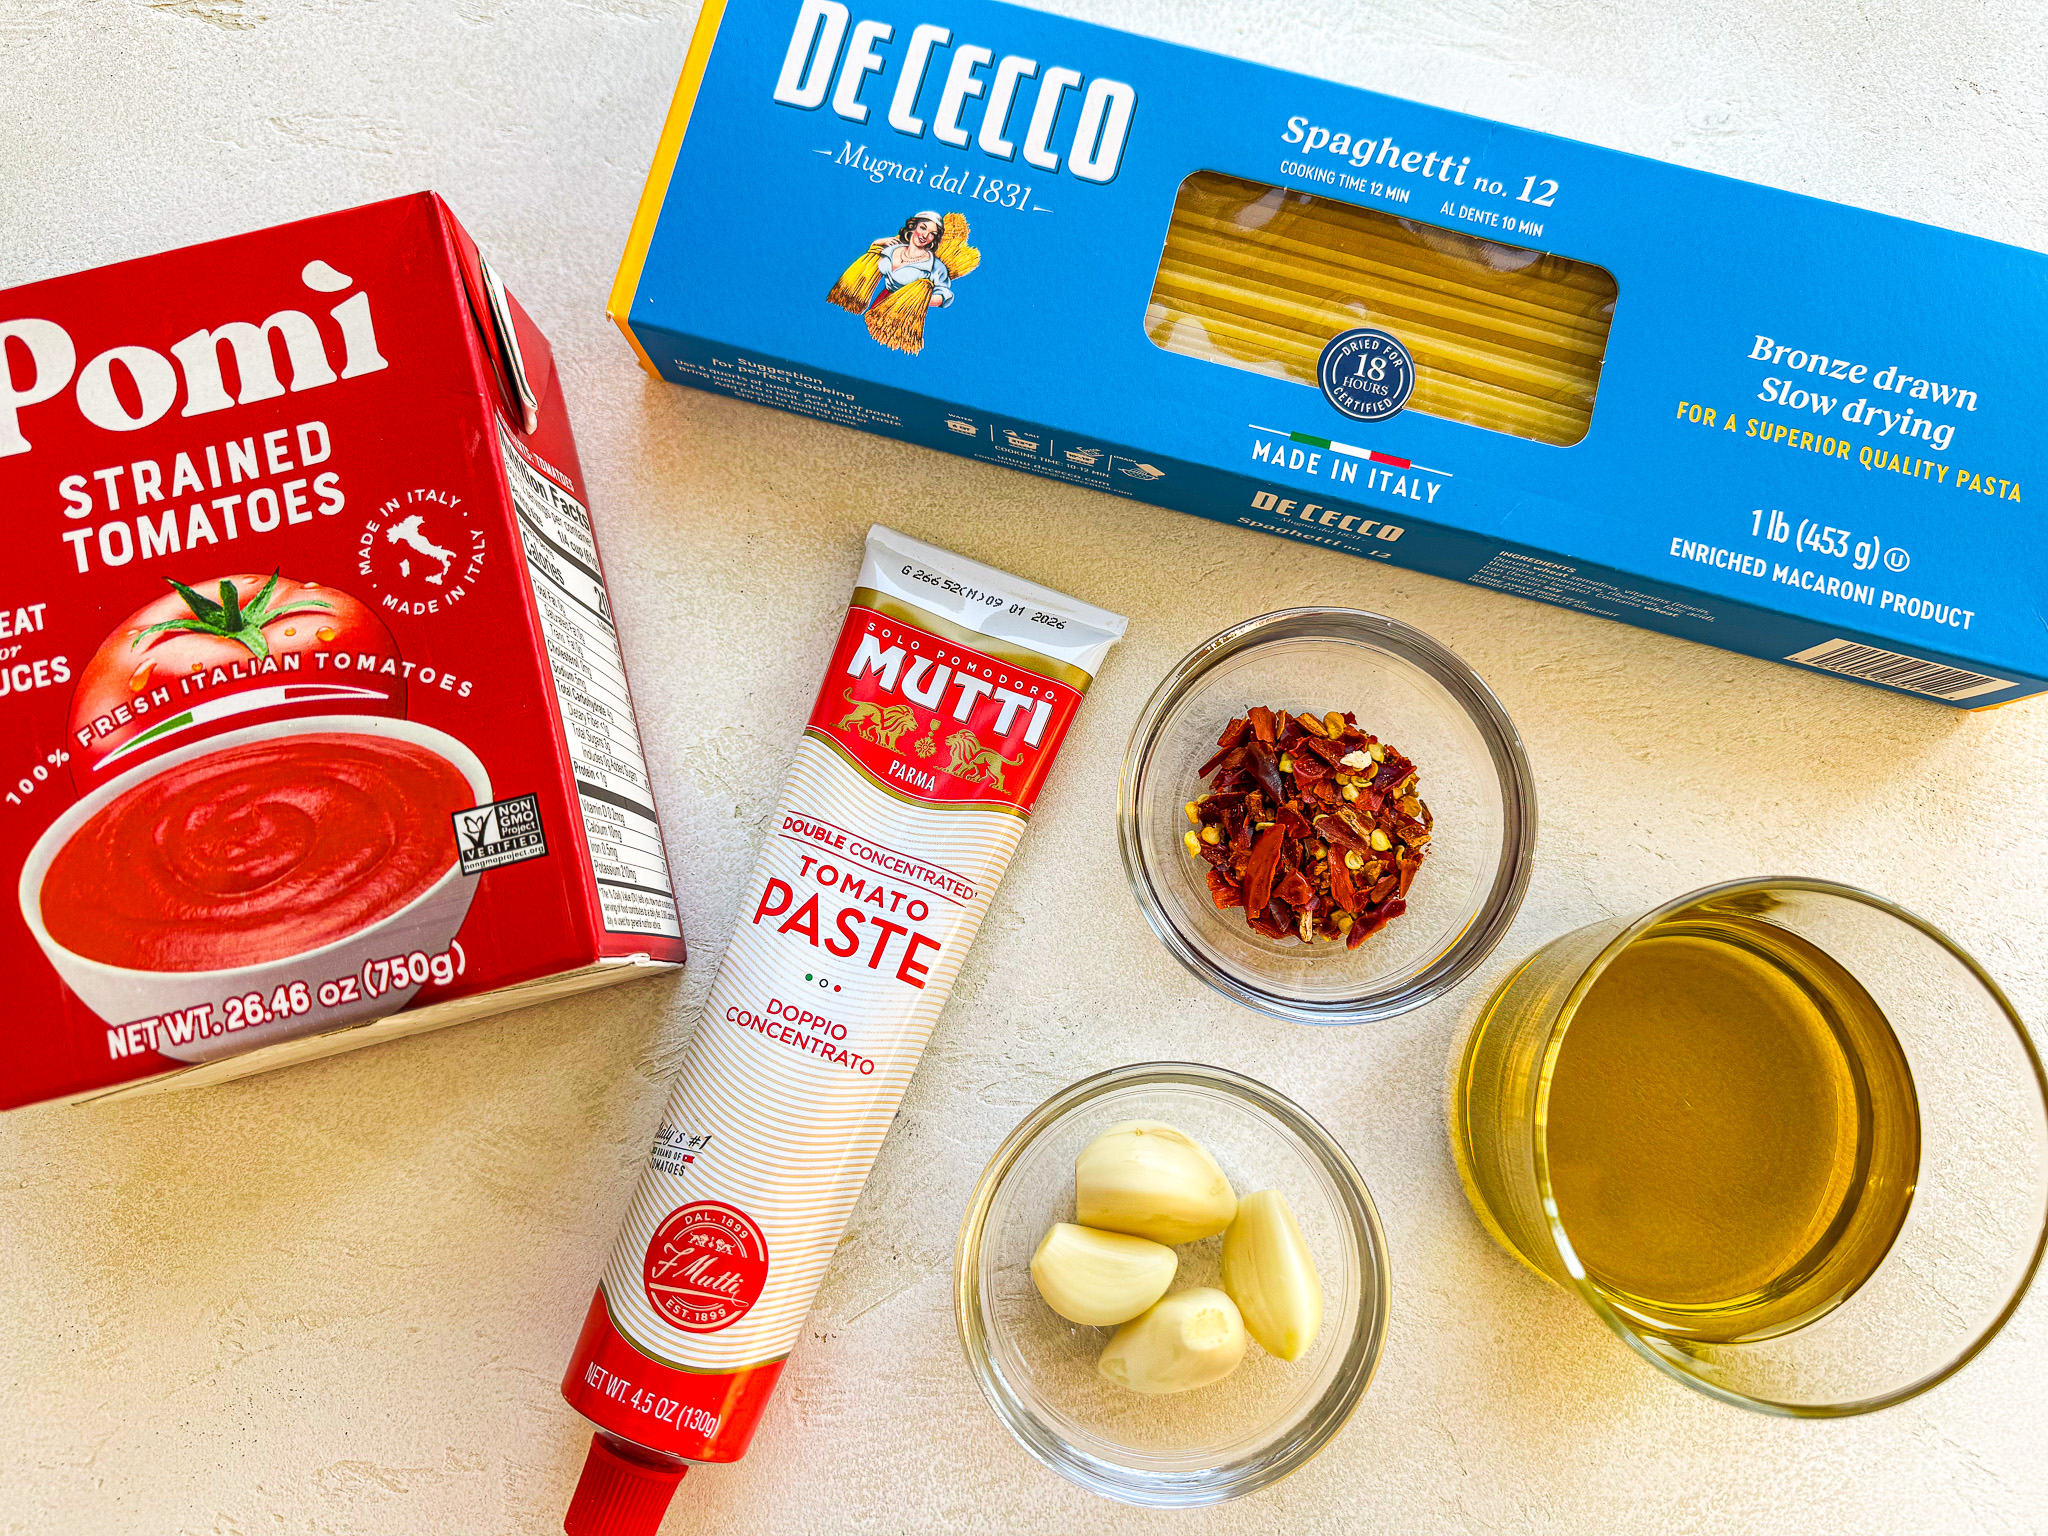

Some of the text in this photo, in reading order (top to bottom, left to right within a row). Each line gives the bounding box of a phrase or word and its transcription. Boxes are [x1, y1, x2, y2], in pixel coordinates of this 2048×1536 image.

[834, 141, 1033, 211] Mugnai dal 1831
[1280, 115, 1560, 208] Spaghetti no. 12
[1280, 160, 1411, 204] COOKING TIME 12 MIN
[1440, 200, 1544, 238] AL DENTE 10 MIN
[0, 260, 389, 458] Pomì
[738, 357, 823, 385] Suggestion
[1342, 339, 1403, 368] DRIED FOR
[1353, 352, 1388, 382] 18
[1748, 334, 1979, 411] Bronze drawn
[674, 359, 696, 369] Use
[708, 368, 748, 382] quarts
[765, 383, 801, 395] water
[803, 393, 824, 401] per
[712, 357, 855, 401] for perfect cooking
[1333, 386, 1393, 413] CERTIFIED
[1342, 376, 1389, 397] HOURS
[1757, 376, 1956, 451] Slow drying
[58, 420, 332, 520] STRAINED
[994, 445, 1037, 460] COOKING
[1039, 456, 1064, 467] TIME:
[1251, 439, 1442, 504] MADE IN ITALY
[1676, 401, 2022, 503] FOR A SUPERIOR QUALITY PASTA
[62, 471, 346, 574] TOMATOES
[548, 484, 590, 531] Facts
[358, 489, 461, 576] MADE IN ITALY
[1236, 516, 1342, 547] Spaghetti
[1366, 549, 1392, 559] 12
[1752, 509, 1763, 537] 1
[1766, 509, 1790, 544] lb
[1796, 518, 1851, 558] (453
[1852, 535, 1881, 571] g)
[382, 530, 486, 615] MADE IN ITALY
[1499, 550, 1577, 573] INGREDIENTS
[901, 564, 913, 576] G
[1008, 604, 1026, 617] 01
[1031, 611, 1068, 630] 2026
[1669, 537, 1976, 630] ENRICHED MACARONI PRODUCT
[867, 622, 920, 650] SOLO
[846, 632, 1054, 749] MUTTI
[6, 652, 473, 806] 100% FRESH ITALIAN TOMATOES
[888, 759, 936, 792] PARMA
[499, 800, 531, 817] NON
[500, 811, 534, 827] GMO
[501, 821, 536, 836] Project
[467, 834, 538, 859] VERIFIED
[782, 816, 847, 849] DOUBLE
[464, 845, 544, 870] nongmoproject.org
[799, 855, 929, 921] TOMATO
[753, 876, 942, 990] PASTE
[106, 938, 467, 1060] NET WT. 26.46 oz (750g)
[766, 998, 848, 1041] DOPPIO
[726, 1006, 875, 1076] CONCENTRATO
[673, 1151, 682, 1161] OF
[688, 1135, 712, 1149] #1
[650, 1157, 686, 1176] TOMATOES
[684, 1211, 749, 1239] DAL. 1899
[672, 1254, 744, 1297] Mutti
[665, 1299, 727, 1322] EST. 1899
[585, 1361, 722, 1439] NET WT. 4.5 OZ (130g)
